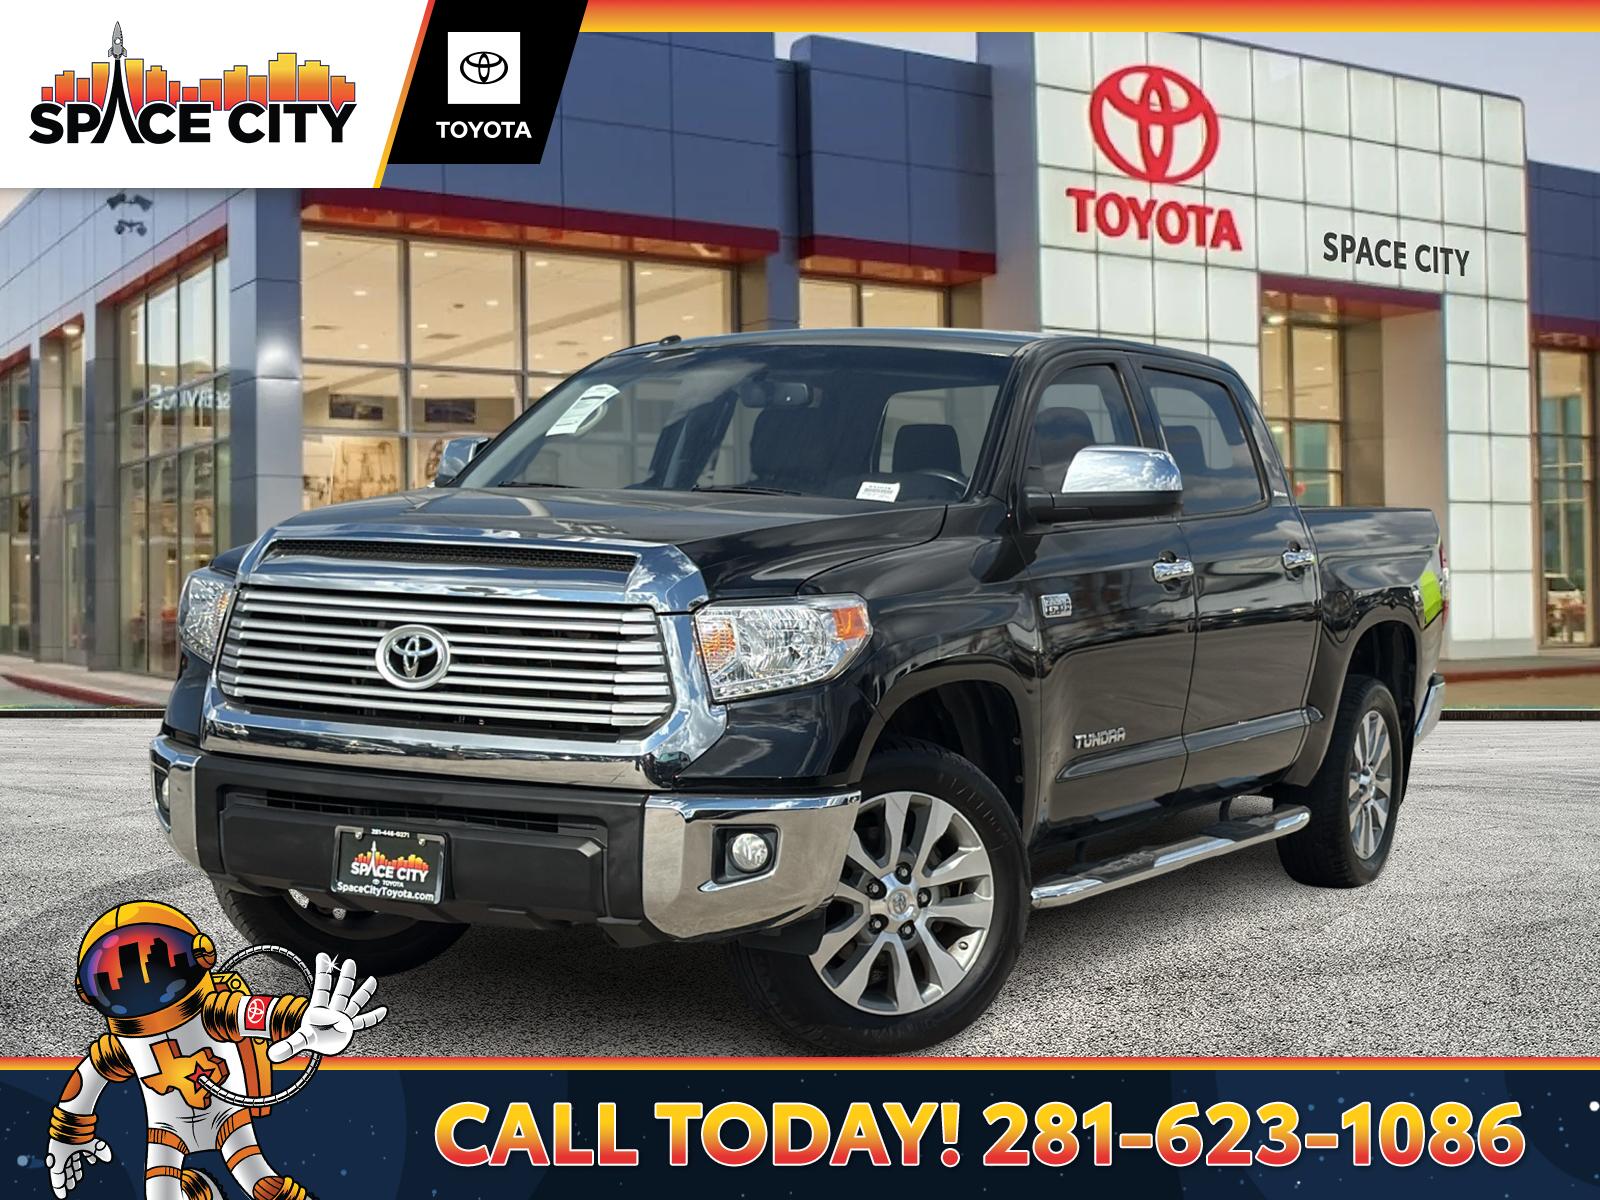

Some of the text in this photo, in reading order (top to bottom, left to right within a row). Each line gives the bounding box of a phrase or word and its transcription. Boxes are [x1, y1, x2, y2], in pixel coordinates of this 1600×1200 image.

[1066, 187, 1242, 252] TOYOTA
[1323, 231, 1470, 277] SPACE CITY
[1073, 727, 1126, 749] TUNDRA
[350, 856, 429, 883] SPACE CITY
[336, 881, 434, 902] SpaceCityToyota.com
[382, 880, 404, 888] TOYOTA
